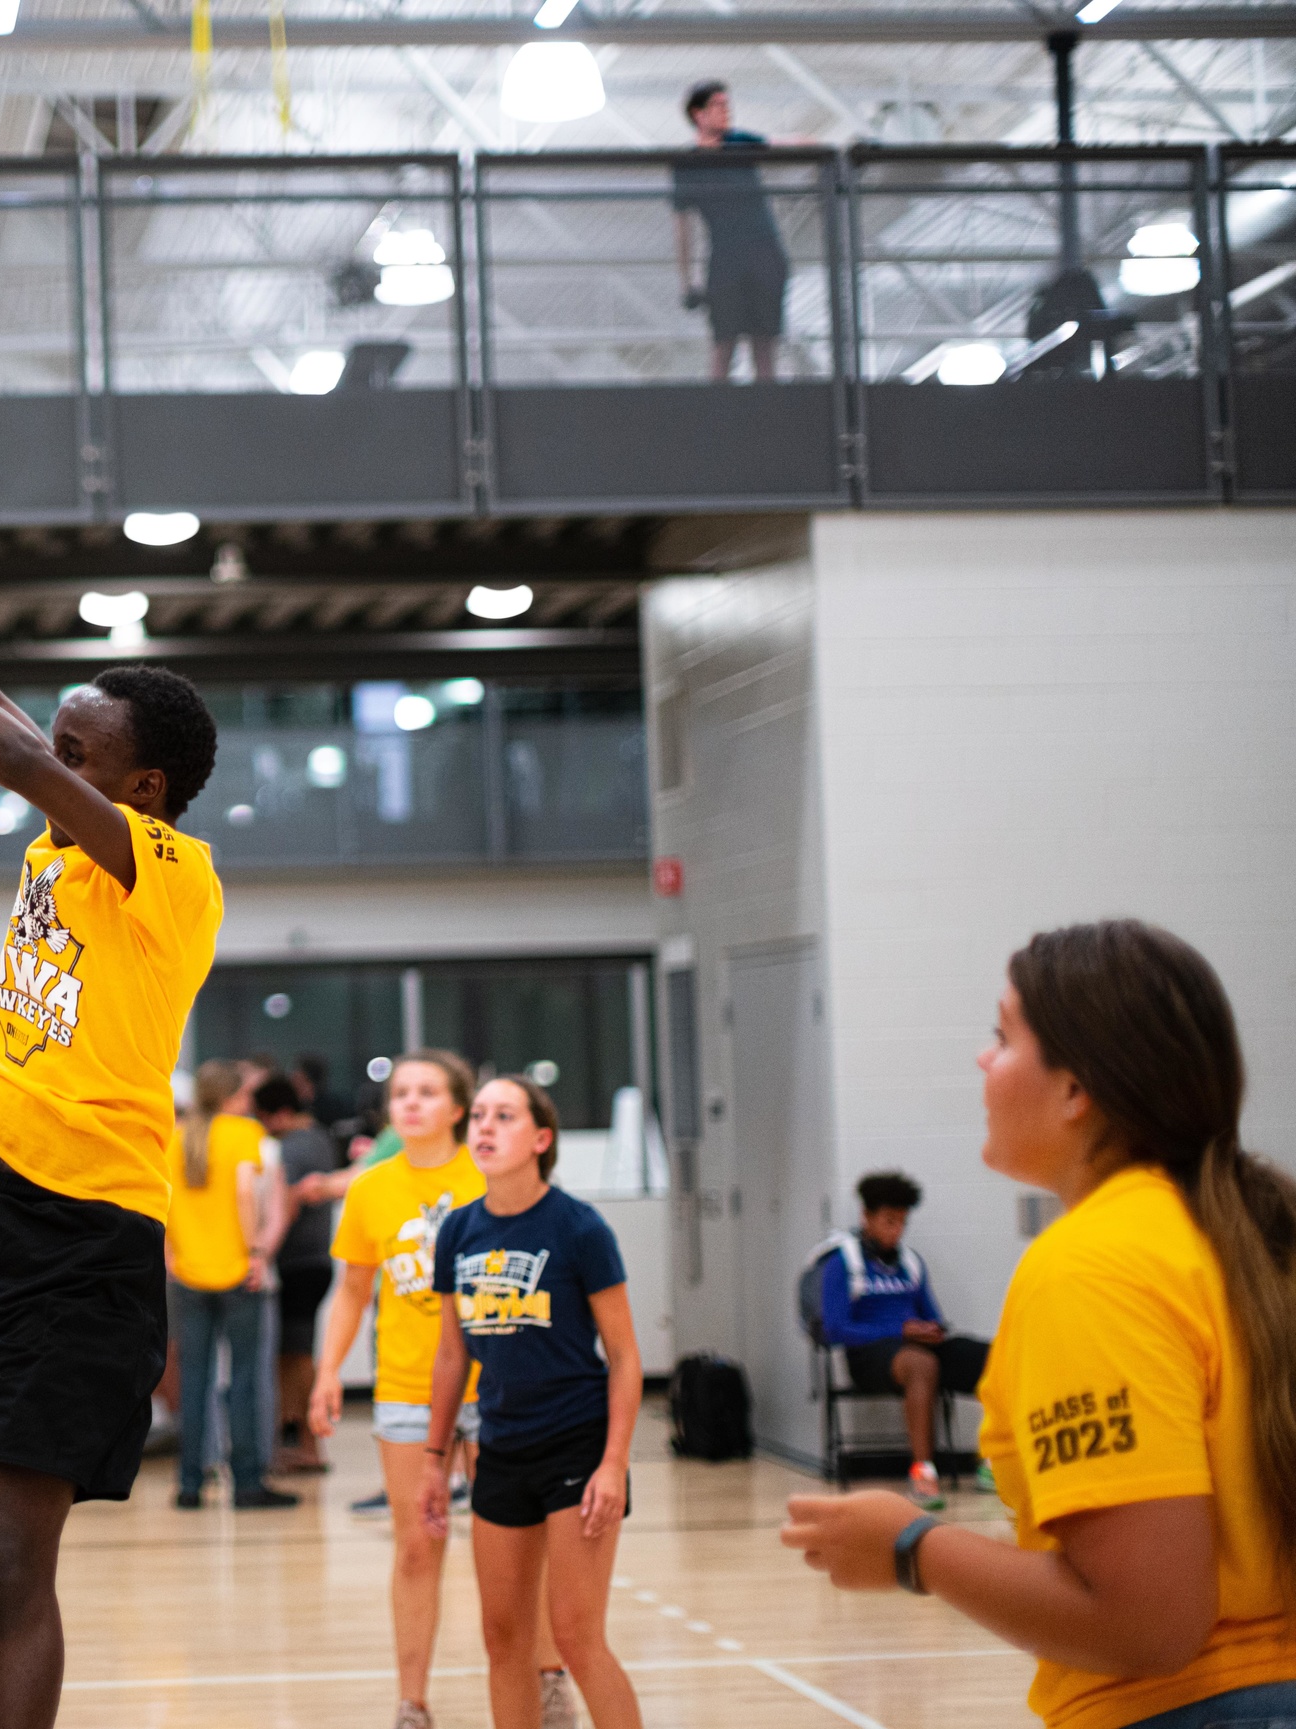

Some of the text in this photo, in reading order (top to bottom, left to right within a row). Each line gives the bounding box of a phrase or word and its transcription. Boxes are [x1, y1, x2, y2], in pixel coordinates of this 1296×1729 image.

[165, 847, 179, 864] of
[1029, 1386, 1129, 1434] CLASS of
[1033, 1413, 1138, 1475] 2023
